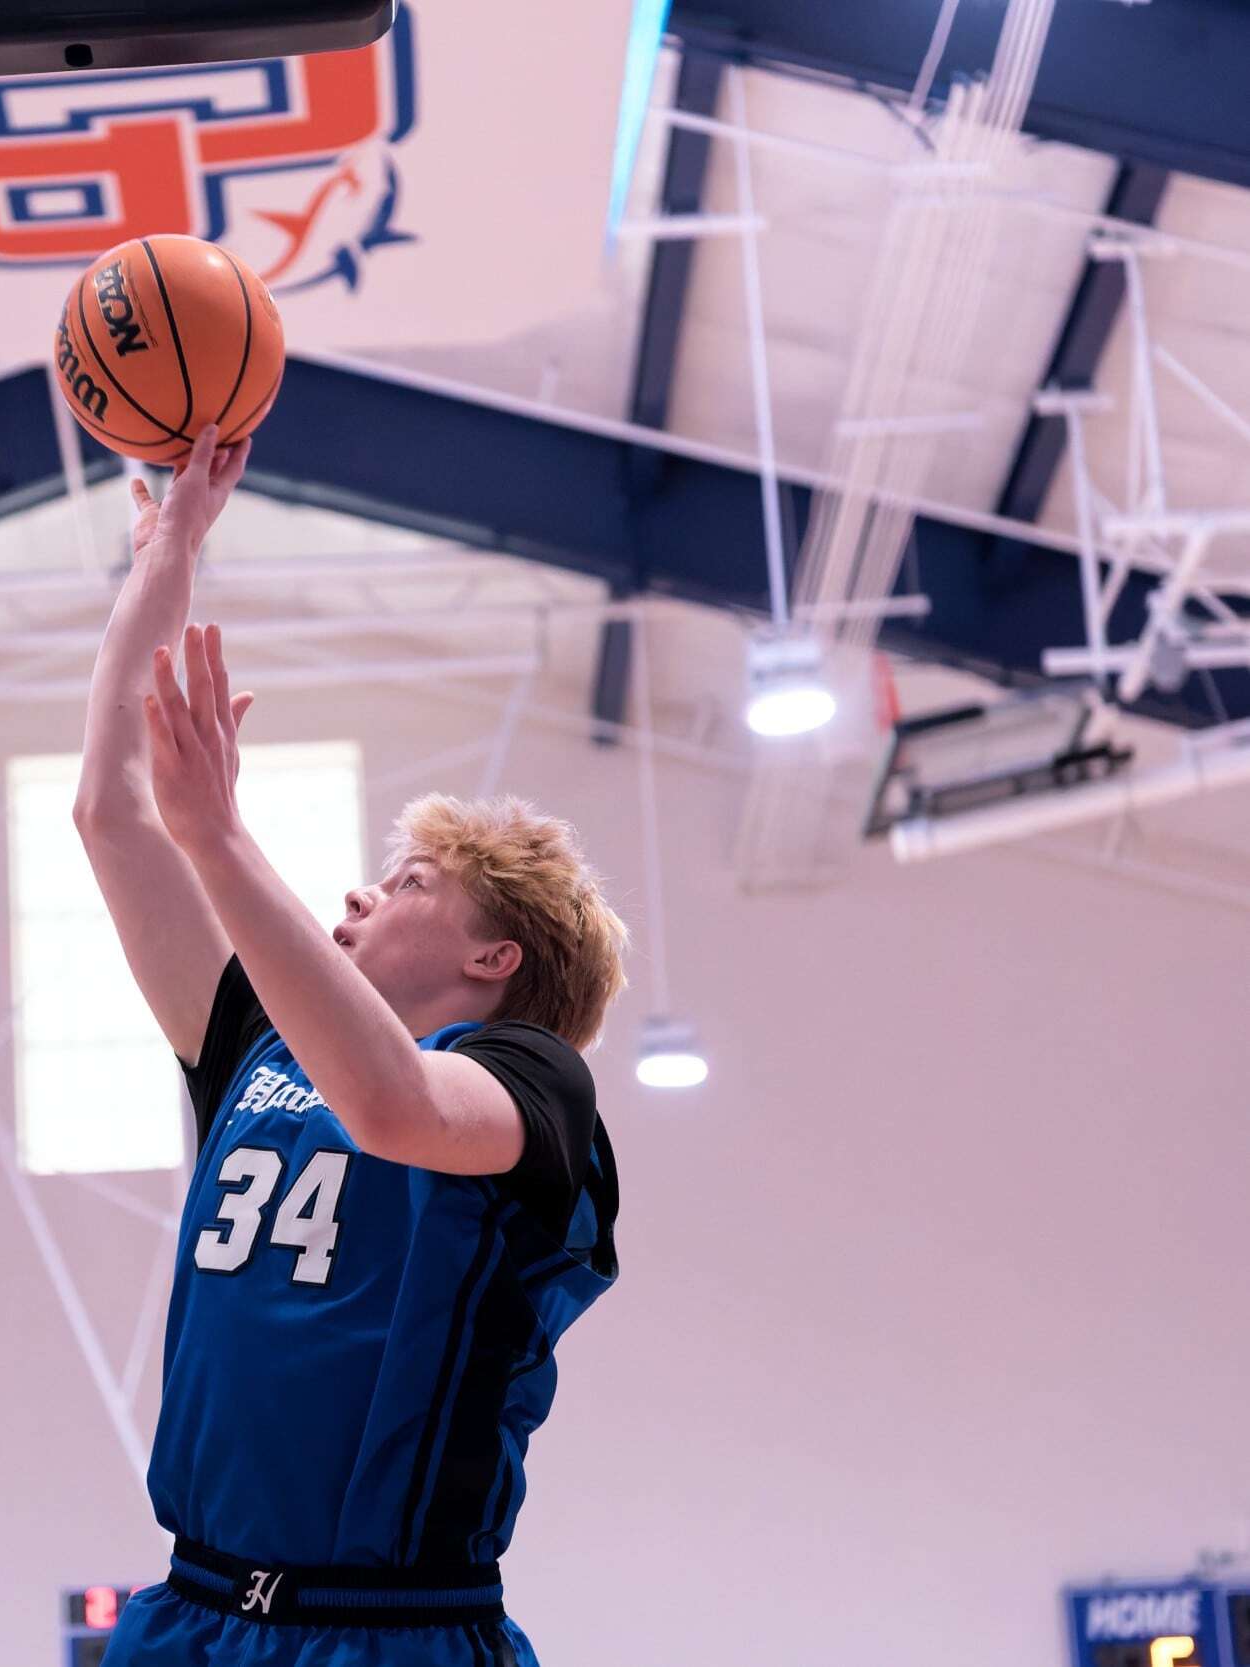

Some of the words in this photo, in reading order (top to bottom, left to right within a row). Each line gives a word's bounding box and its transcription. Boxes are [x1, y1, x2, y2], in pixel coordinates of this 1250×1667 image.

[93, 259, 149, 357] NCAA
[193, 1144, 351, 1286] 34
[241, 1570, 283, 1614] H
[1087, 1591, 1199, 1641] HOME
